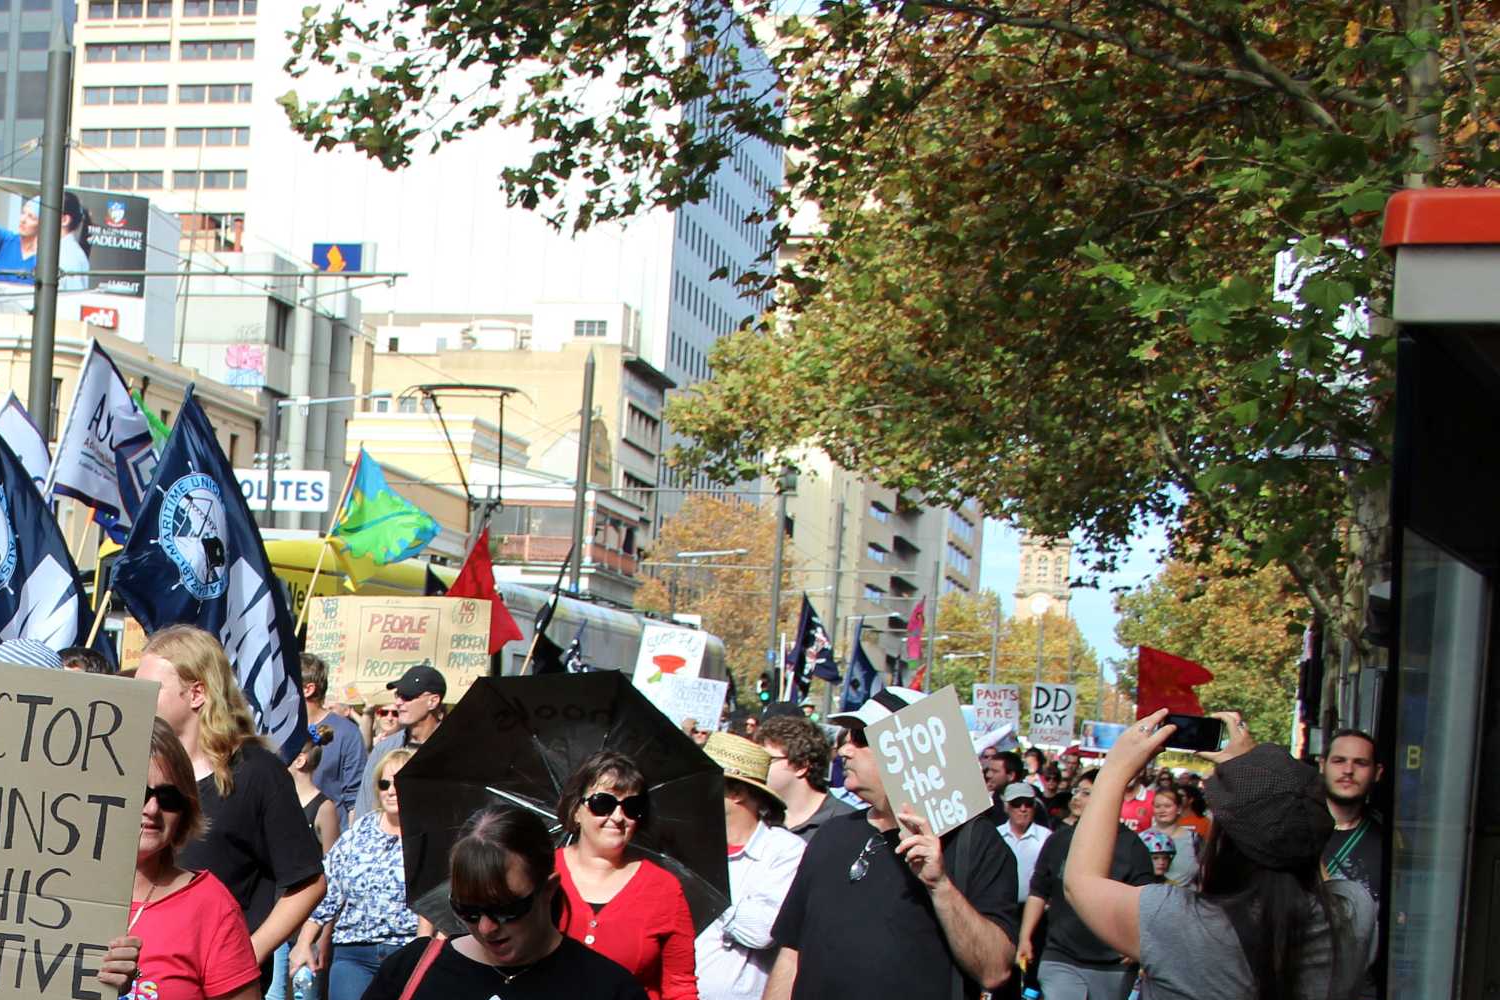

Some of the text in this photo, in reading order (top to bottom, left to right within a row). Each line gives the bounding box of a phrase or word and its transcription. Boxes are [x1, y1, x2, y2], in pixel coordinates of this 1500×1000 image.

[88, 225, 142, 240] THE UNIVERSITY
[93, 236, 142, 250] ADELAIDE
[241, 480, 324, 501] OLITES
[163, 483, 188, 556] MARITIME
[460, 601, 476, 612] NO
[368, 613, 430, 633] PEOPLE
[459, 612, 475, 624] TO
[380, 635, 421, 651] BEFORE
[451, 634, 488, 650] BROKEN
[448, 652, 488, 673] PROMISES
[976, 688, 1019, 701] PANTS
[976, 709, 1013, 719] FIRE
[1034, 713, 1068, 726] DAY
[902, 765, 945, 804] the
[924, 790, 968, 835] lies
